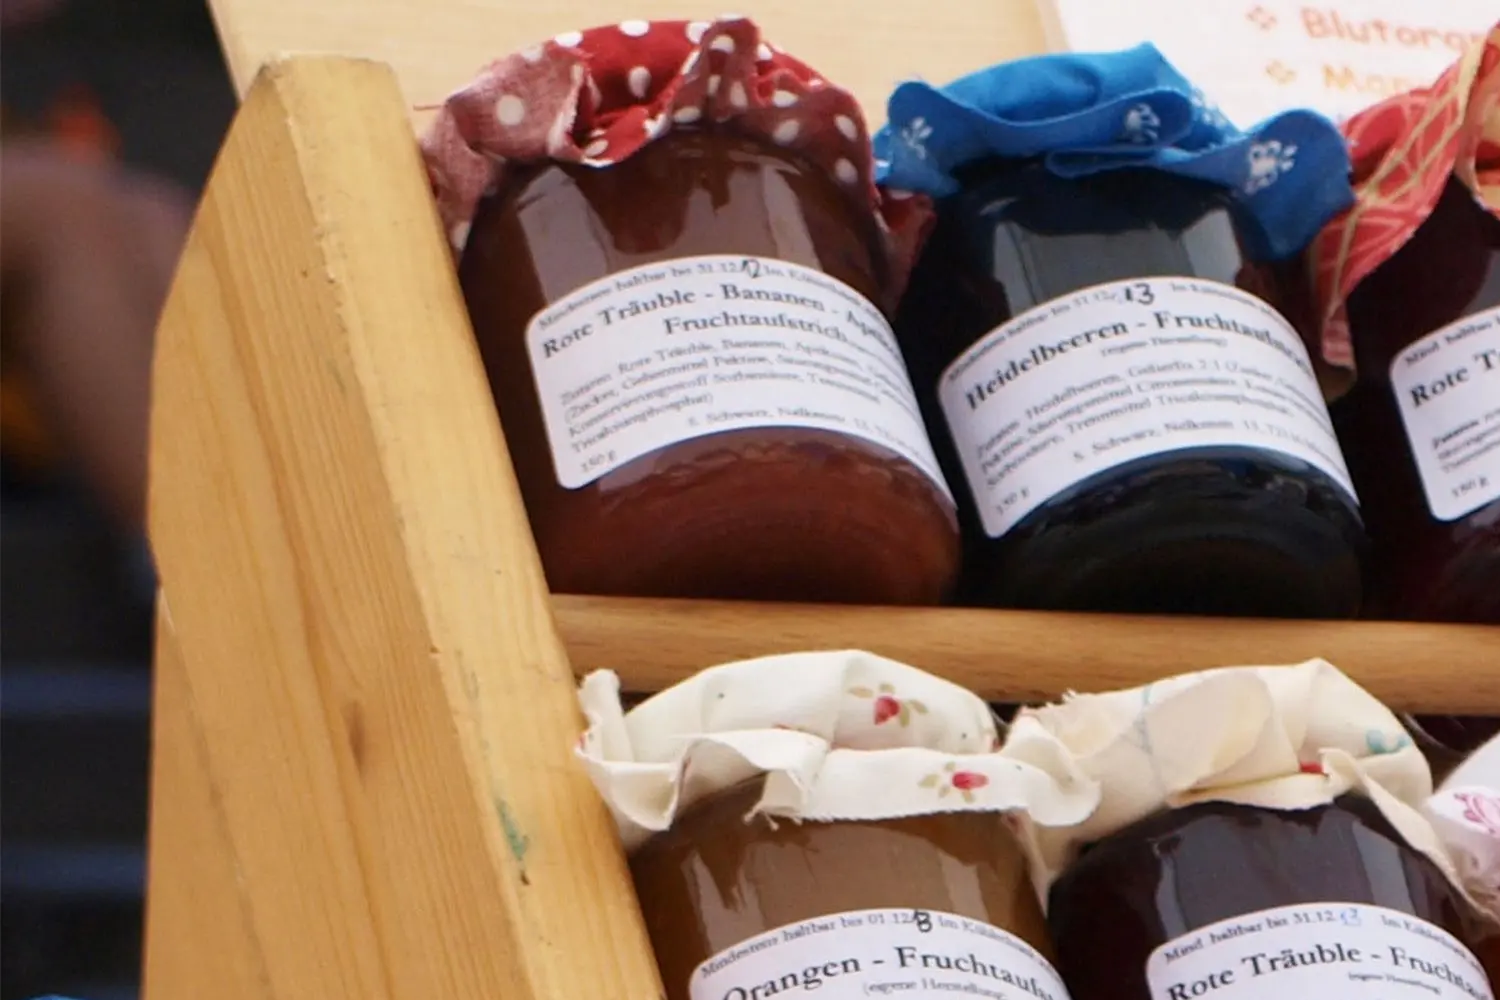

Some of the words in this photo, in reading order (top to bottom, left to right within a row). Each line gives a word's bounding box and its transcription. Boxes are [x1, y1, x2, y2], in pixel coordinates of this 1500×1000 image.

[542, 324, 594, 360] Rote
[598, 288, 696, 327] Träuble
[720, 282, 825, 313] Bananen
[663, 310, 846, 343] Fruchtaufstrich
[965, 320, 1130, 410] Heidelbeeren
[1409, 366, 1470, 408] Rote
[1241, 943, 1362, 978] Träuble
